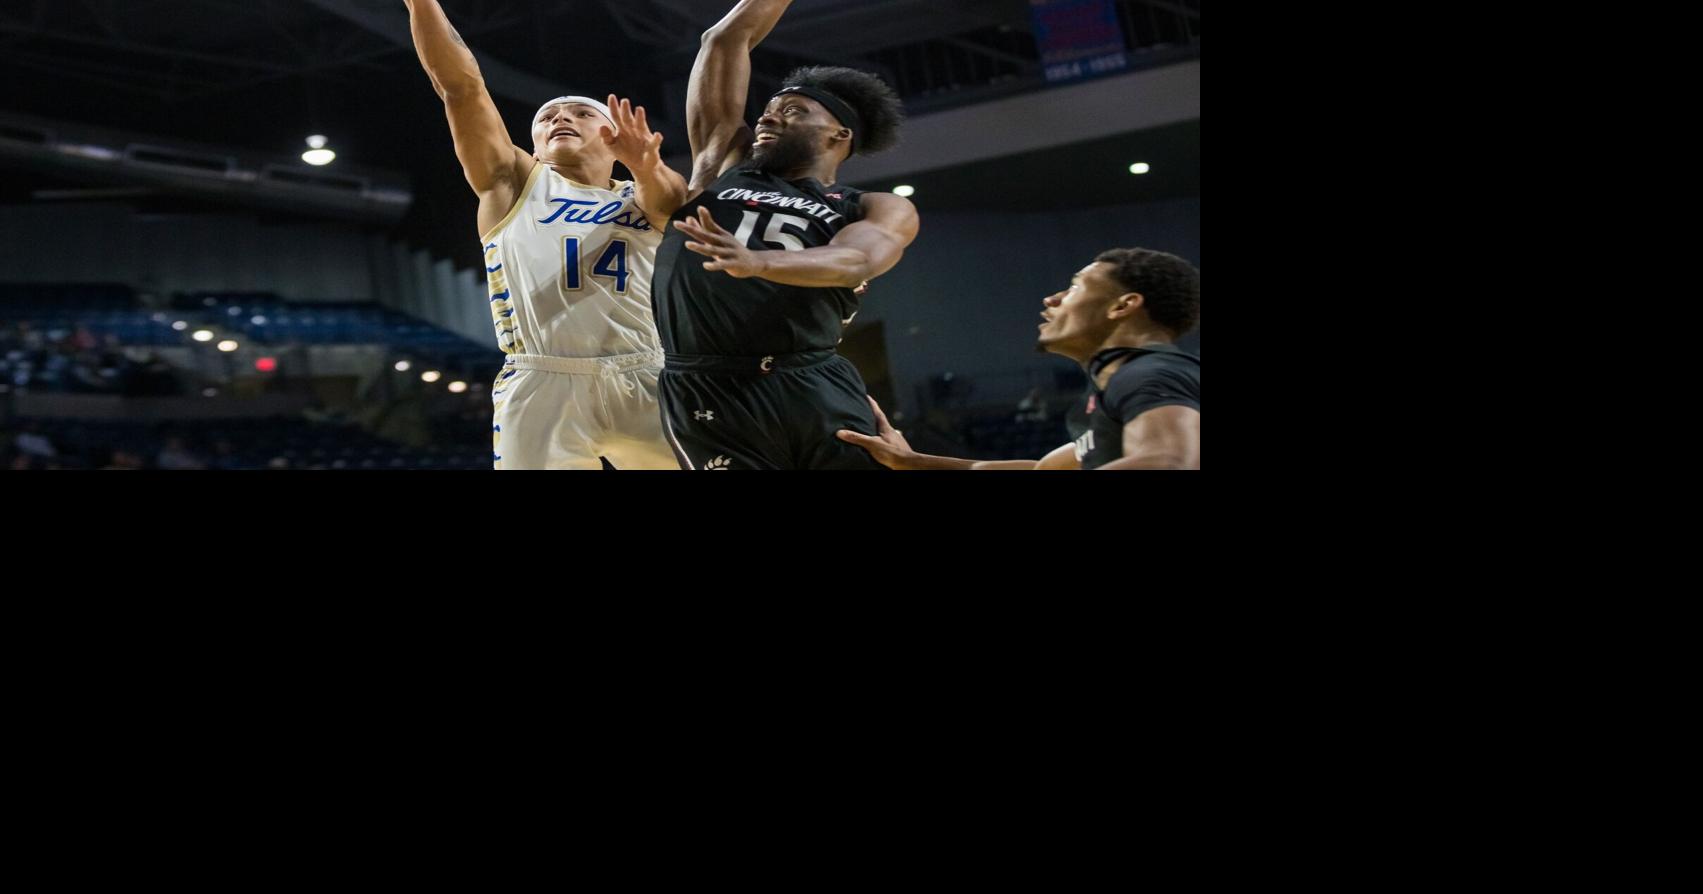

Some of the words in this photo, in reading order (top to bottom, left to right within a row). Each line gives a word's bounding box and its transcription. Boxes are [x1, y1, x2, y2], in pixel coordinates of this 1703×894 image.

[538, 198, 651, 230] Tulsa
[717, 187, 842, 224] CINCINNATI
[734, 210, 810, 251] 15
[563, 236, 631, 294] 14
